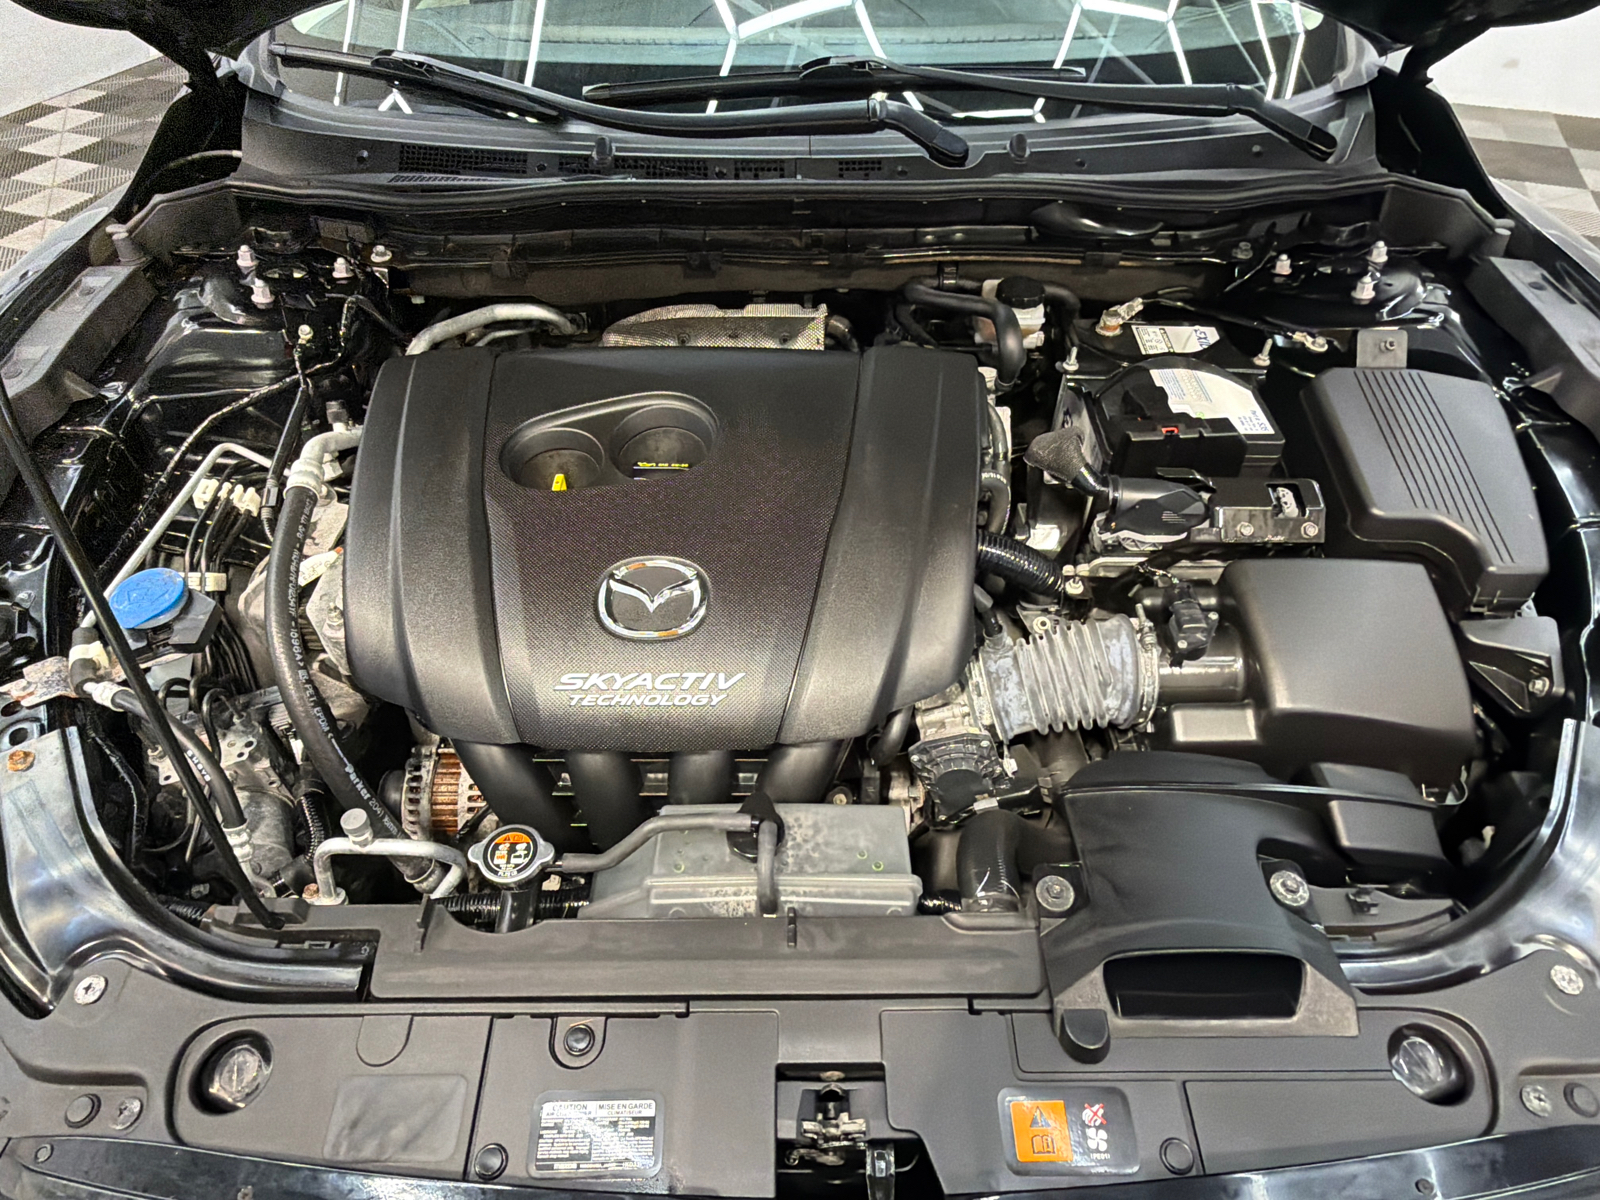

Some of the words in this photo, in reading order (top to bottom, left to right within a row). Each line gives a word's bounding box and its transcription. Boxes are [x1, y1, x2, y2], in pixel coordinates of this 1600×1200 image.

[553, 672, 746, 691] SKYACTIV
[569, 694, 728, 707] TECHNOLOGY
[345, 763, 371, 800] Parker
[628, 1102, 653, 1110] GARDE
